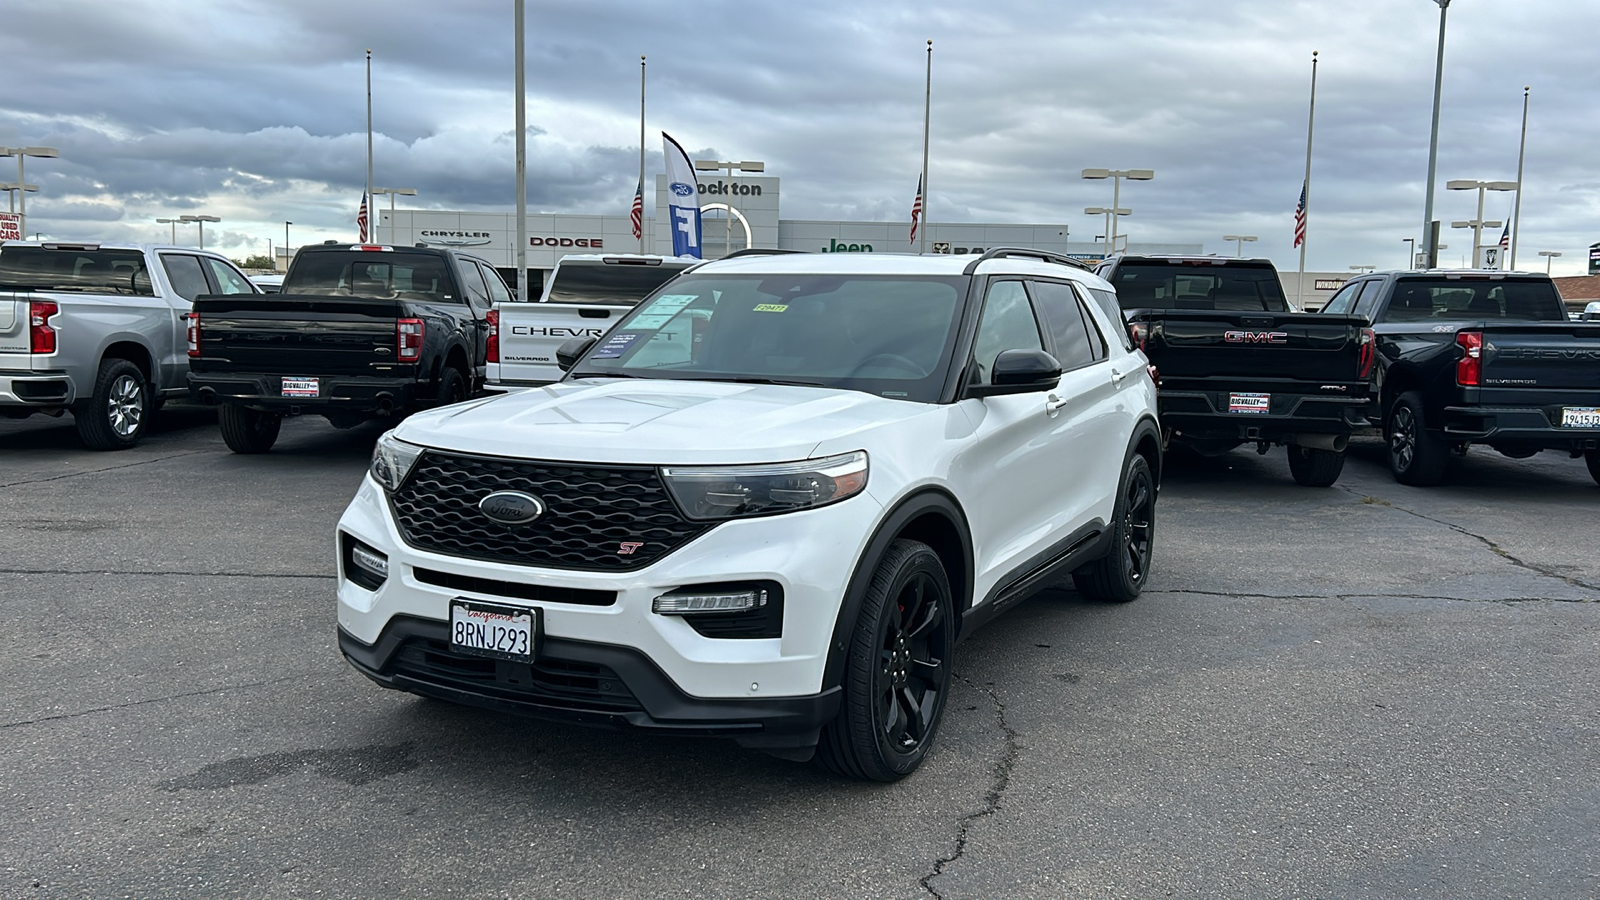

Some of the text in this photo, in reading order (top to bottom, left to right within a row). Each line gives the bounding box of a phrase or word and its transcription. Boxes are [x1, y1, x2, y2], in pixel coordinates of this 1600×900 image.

[697, 181, 762, 196] ockton
[1, 222, 18, 231] USED
[0, 230, 20, 241] CARS
[421, 230, 490, 238] CHRYSLER
[530, 237, 603, 248] DODGE
[954, 247, 991, 255] RA
[1316, 281, 1344, 289] WINDOW
[1224, 330, 1288, 344] GMC
[491, 497, 527, 517] Ford
[617, 541, 644, 554] ST
[455, 621, 528, 654] 8RNJ293
